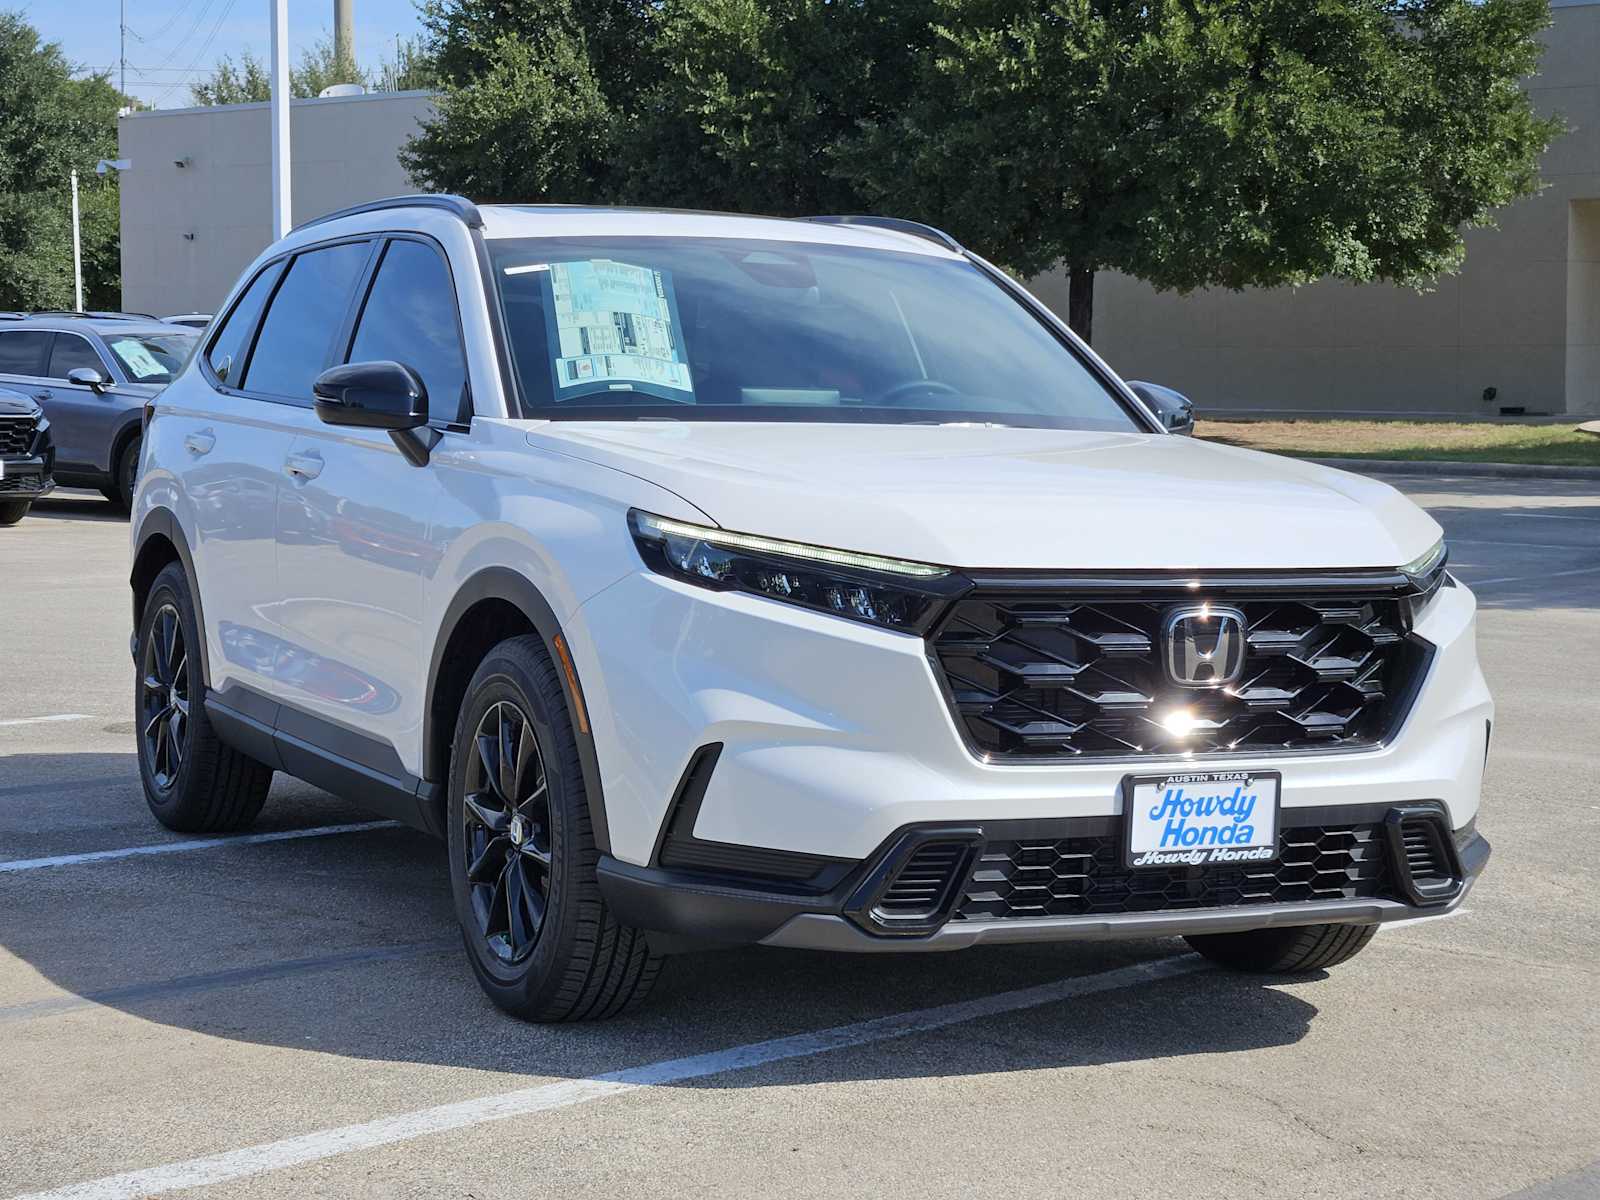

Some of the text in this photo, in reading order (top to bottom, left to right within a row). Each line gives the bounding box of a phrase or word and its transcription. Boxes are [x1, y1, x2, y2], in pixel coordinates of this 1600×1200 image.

[1167, 773, 1249, 783] AUSTIN TEXAS
[1150, 787, 1257, 823] Howdy
[1159, 818, 1254, 848] Honda
[1133, 847, 1274, 866] Howdy Honda
